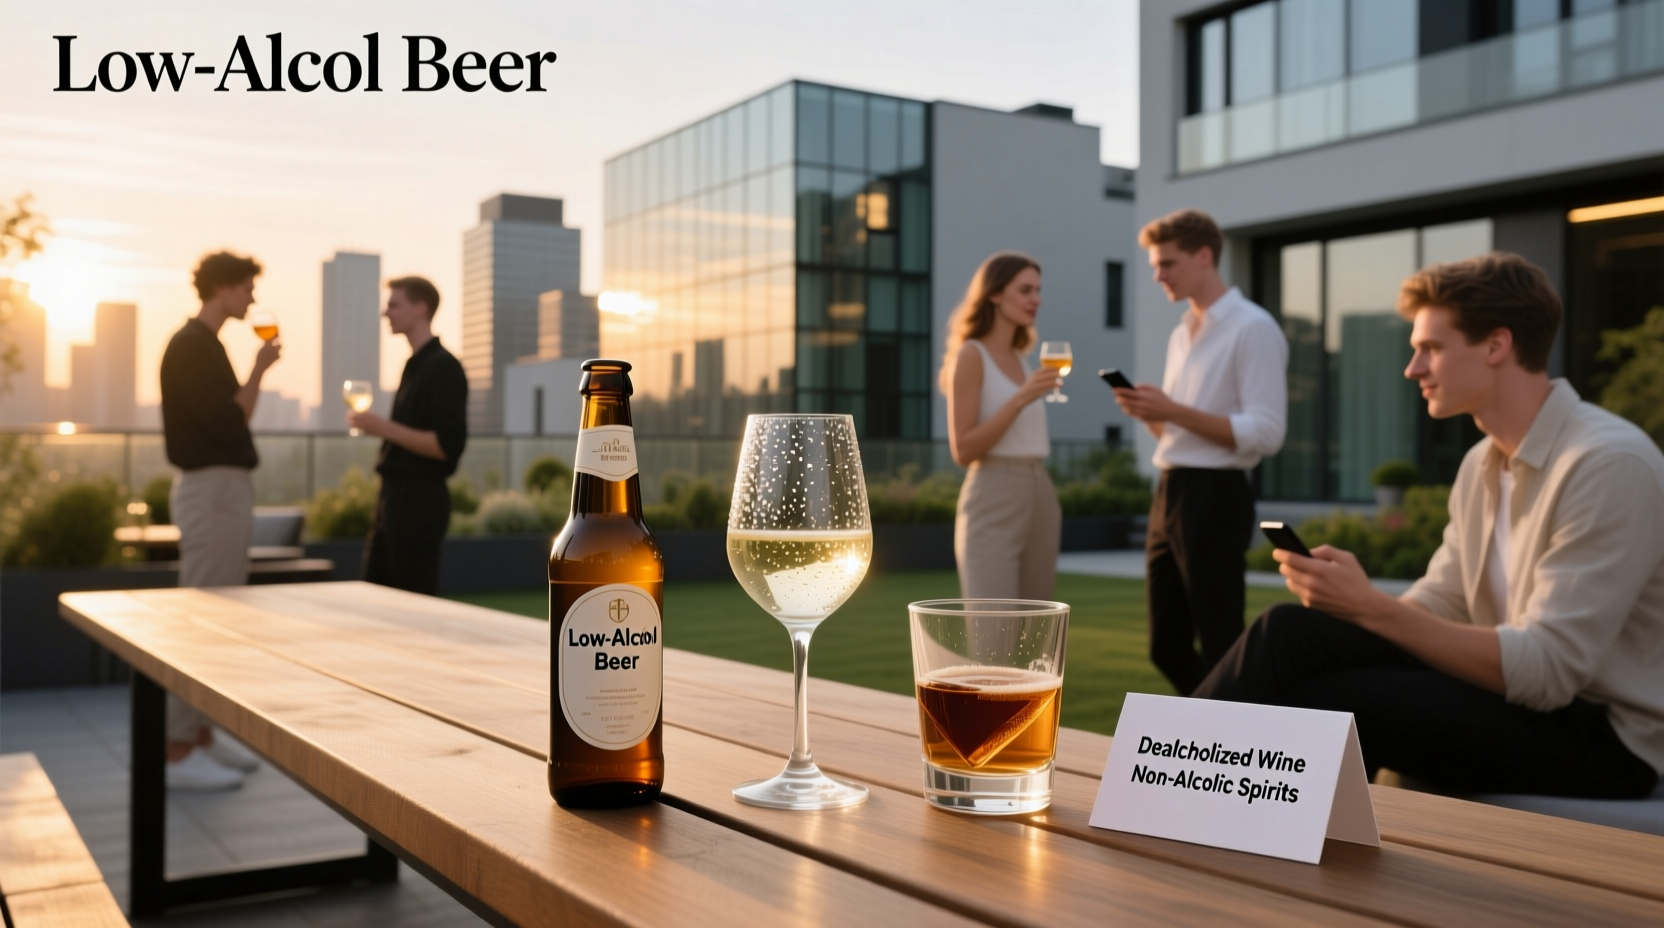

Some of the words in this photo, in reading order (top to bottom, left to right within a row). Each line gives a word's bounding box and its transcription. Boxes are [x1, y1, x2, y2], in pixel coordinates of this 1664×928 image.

[595, 652, 640, 670] Beer
[1137, 735, 1254, 767] Dealcholized
[1258, 749, 1306, 773] Wine
[1131, 764, 1234, 794] Non-Alcolic
[1237, 777, 1299, 804] Spirits
